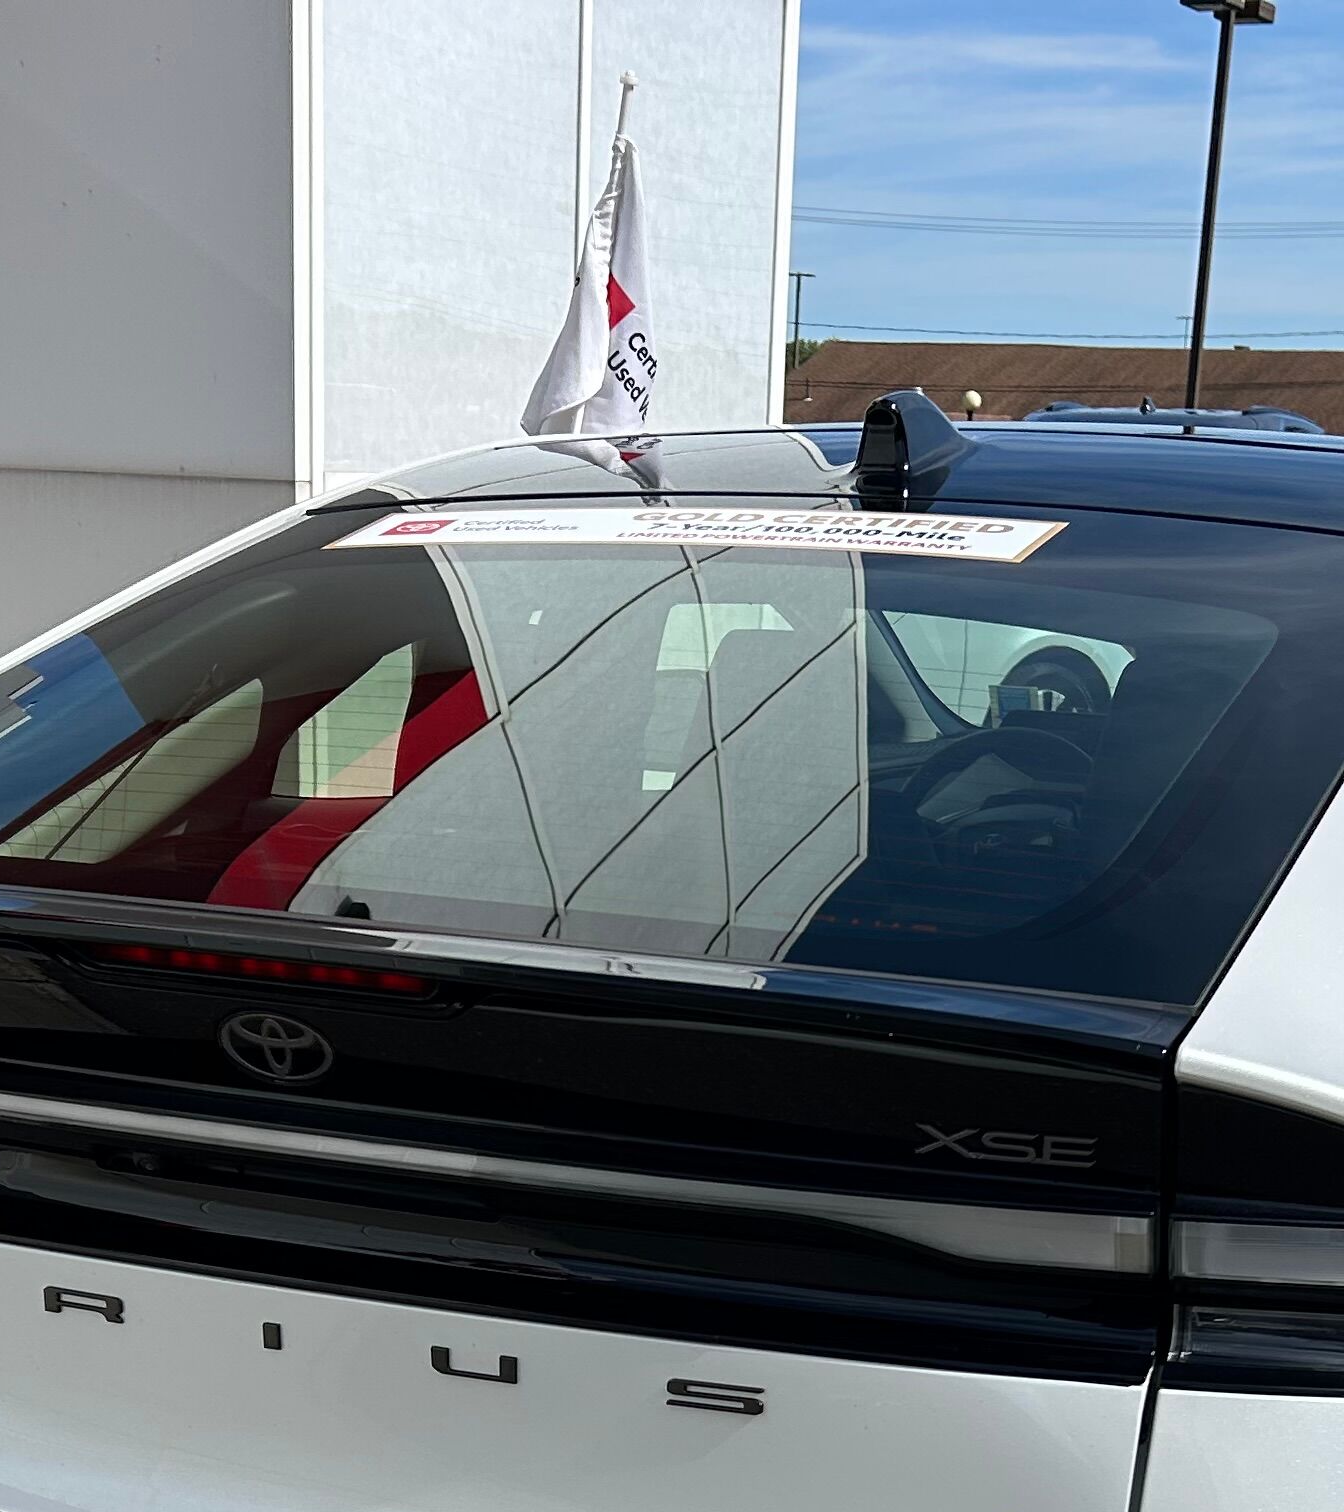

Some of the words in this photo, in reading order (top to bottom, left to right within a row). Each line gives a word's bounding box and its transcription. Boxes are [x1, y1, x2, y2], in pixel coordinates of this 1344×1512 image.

[607, 350, 646, 403] Used
[452, 524, 503, 532] Used
[504, 524, 581, 532] Vehicles
[463, 518, 546, 527] Certified
[633, 511, 768, 524] GOLD
[772, 513, 1015, 535] CERTIFIED
[616, 531, 699, 540] LIMITED
[699, 532, 843, 544] POWERTRAIN
[845, 537, 973, 552] WARRANTY
[914, 1122, 1098, 1168] XSE
